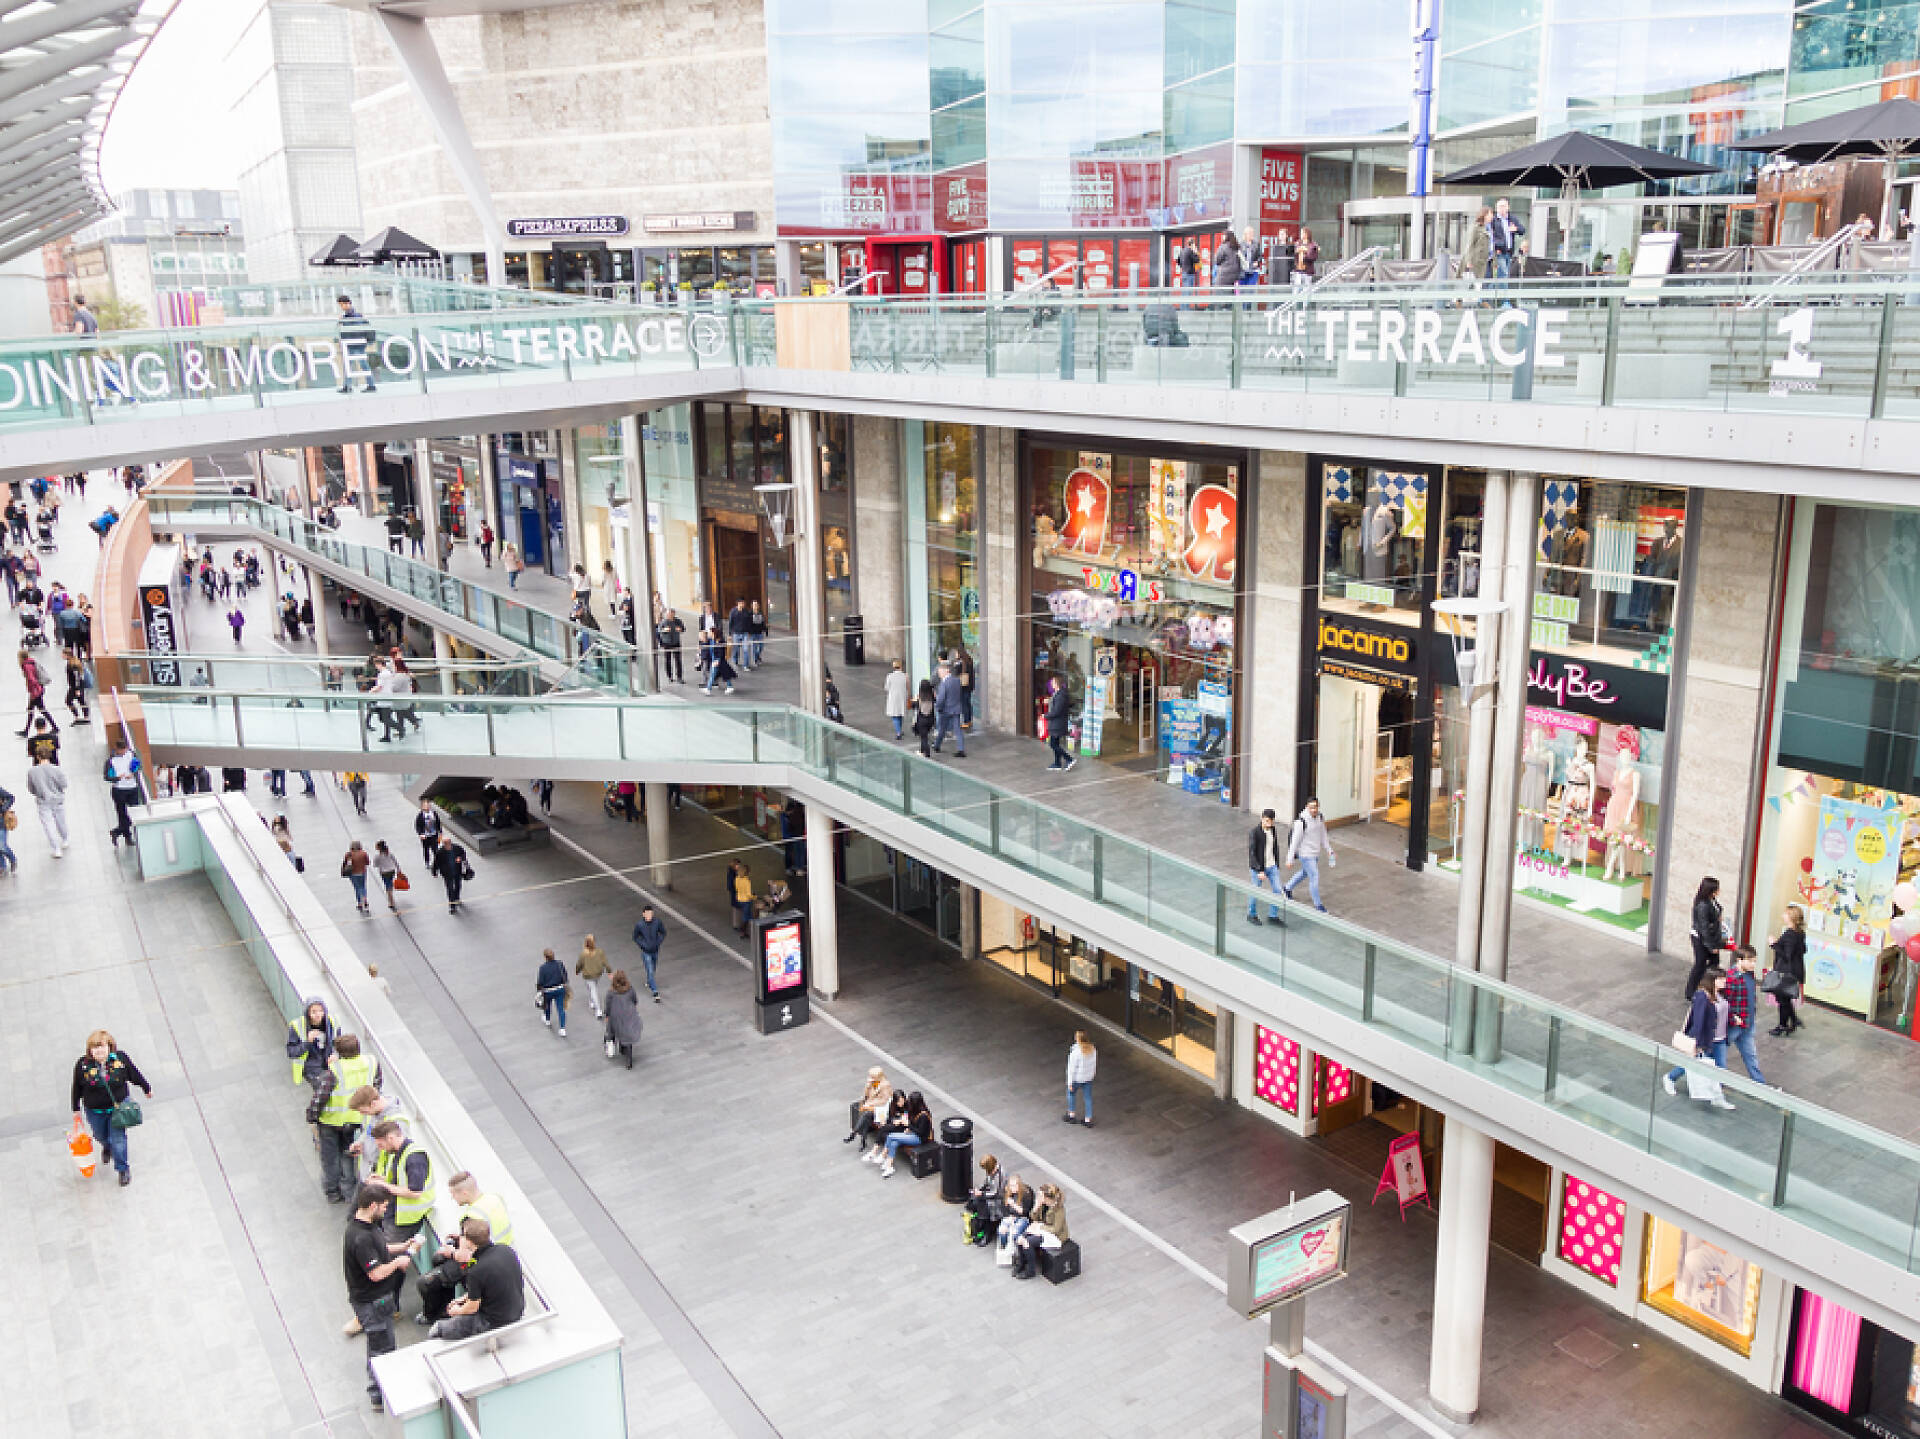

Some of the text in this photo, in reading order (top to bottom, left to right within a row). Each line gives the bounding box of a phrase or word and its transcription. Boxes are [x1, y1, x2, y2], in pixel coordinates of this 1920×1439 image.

[1260, 179, 1299, 202] GUYS
[1263, 158, 1296, 180] FIVE
[185, 348, 217, 392] &
[225, 338, 372, 387] MORE
[383, 333, 452, 375] ON
[452, 330, 495, 350] THE
[502, 318, 687, 365] TERRACE
[1264, 309, 1569, 367] THE TERRACE
[1316, 616, 1410, 662] jacamo
